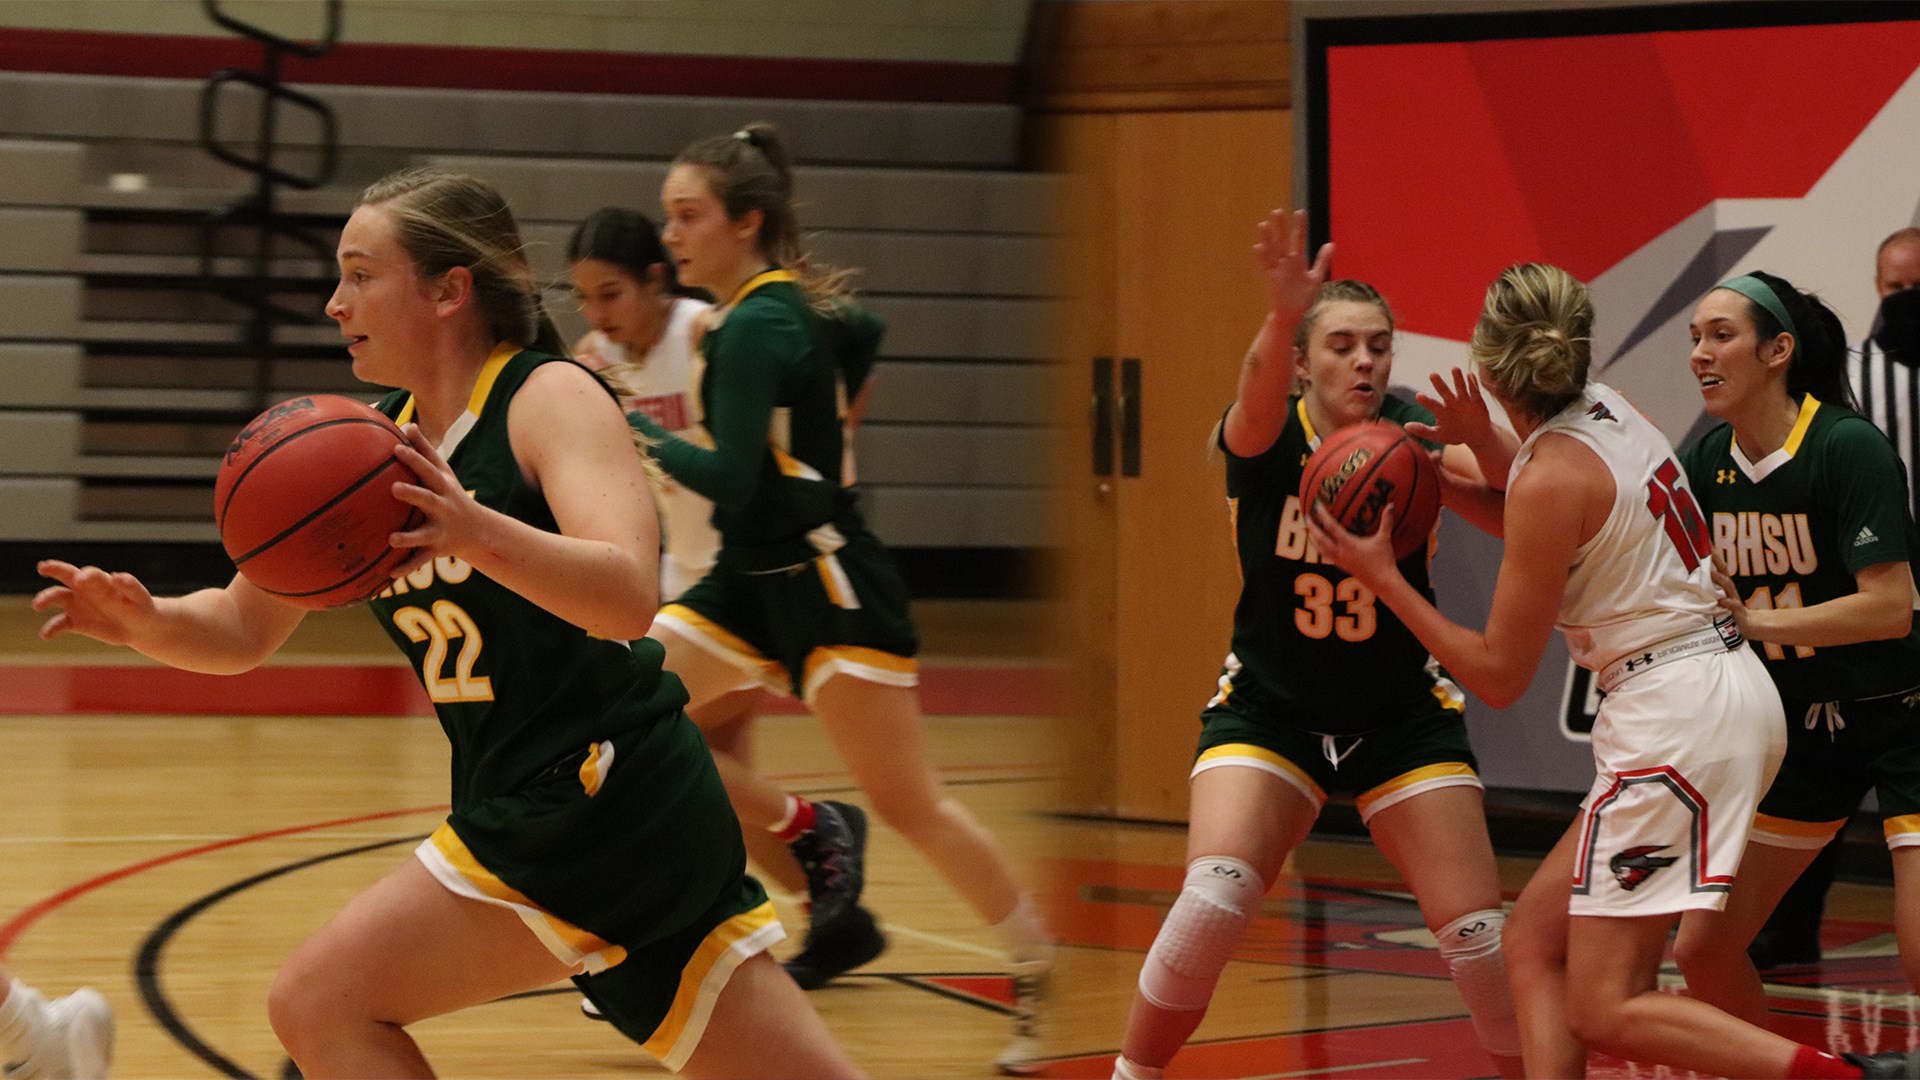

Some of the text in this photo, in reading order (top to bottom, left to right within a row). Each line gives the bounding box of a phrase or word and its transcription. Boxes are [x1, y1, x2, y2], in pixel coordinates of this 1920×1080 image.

[1712, 511, 1818, 577] BHSU
[1294, 573, 1377, 643] 33
[392, 599, 495, 704] 22
